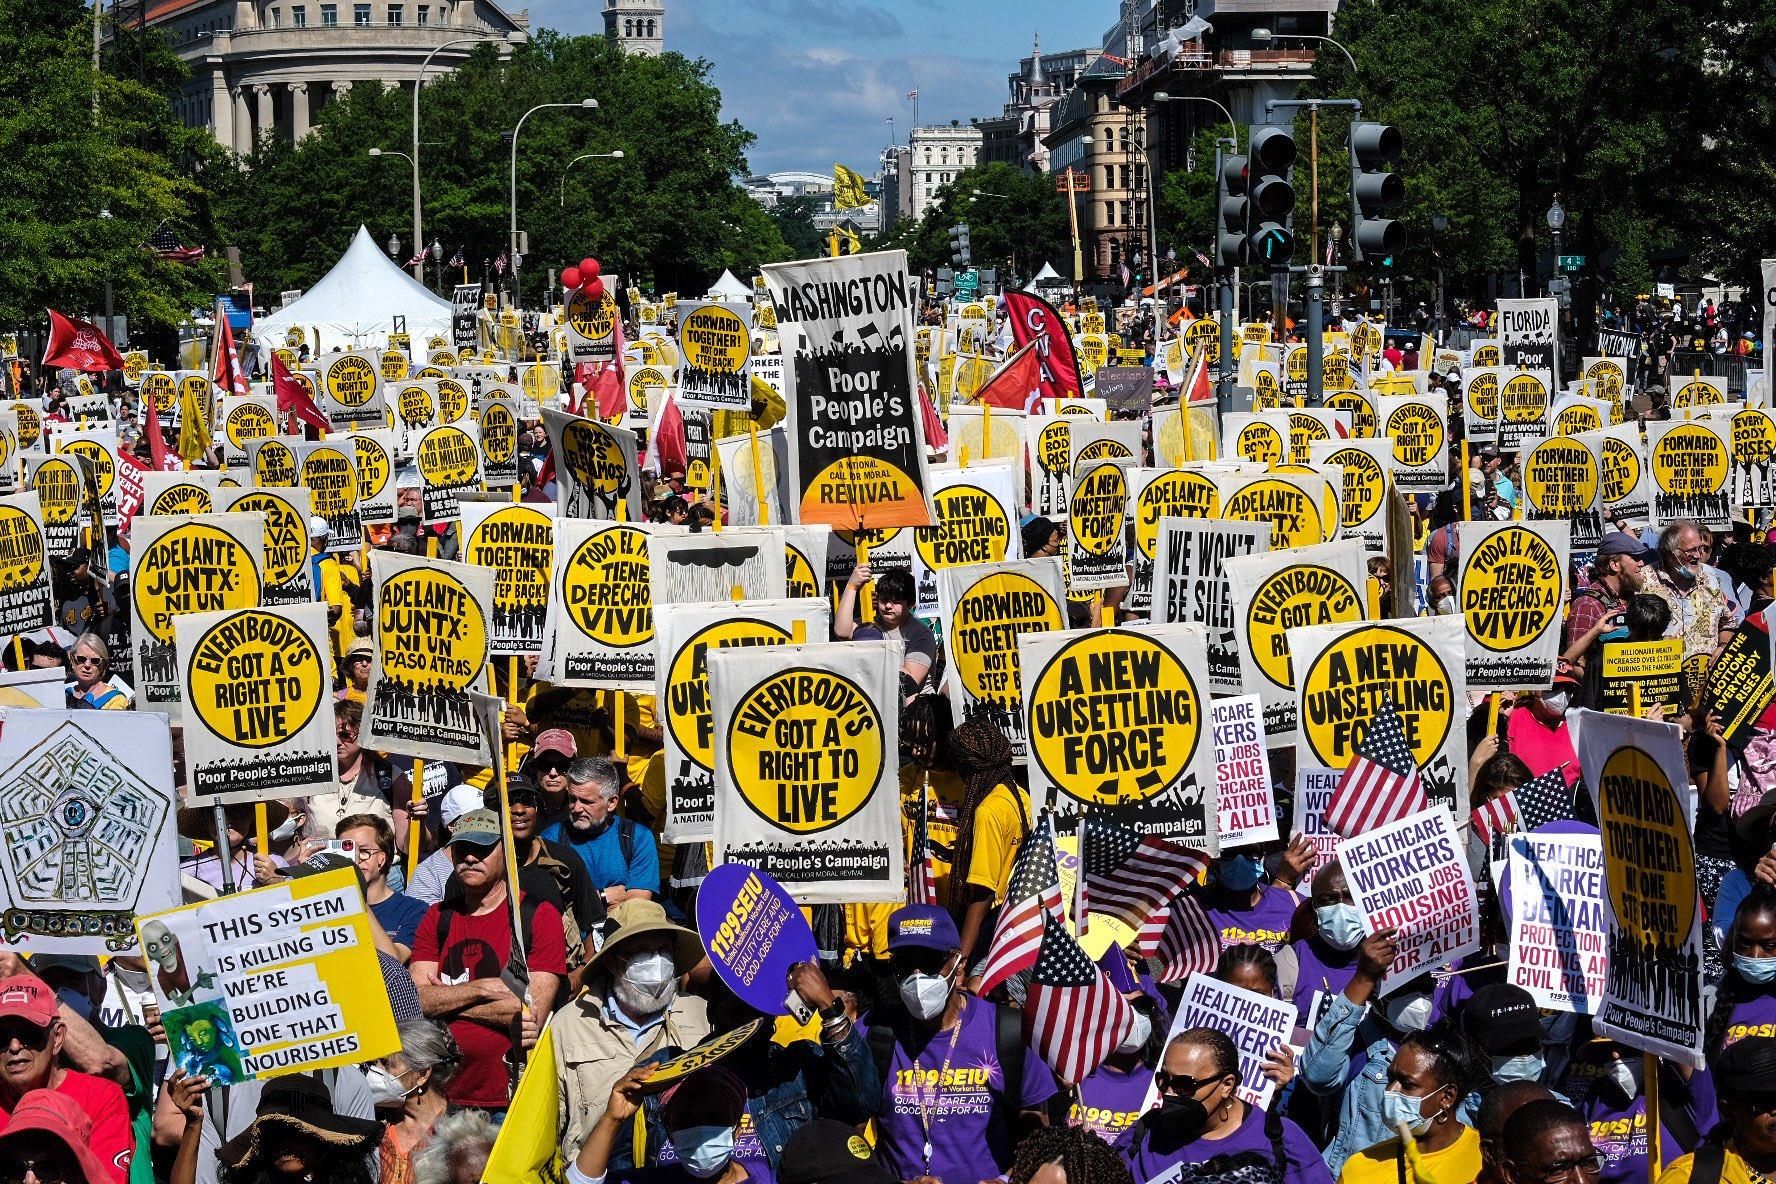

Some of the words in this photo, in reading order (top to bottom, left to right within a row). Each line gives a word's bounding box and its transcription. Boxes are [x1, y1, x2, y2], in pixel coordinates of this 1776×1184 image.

[769, 270, 907, 324] WASHINGTON
[577, 321, 611, 334] VIVIR
[690, 315, 740, 332] FORWARD
[1192, 325, 1198, 335] A
[1200, 325, 1217, 334] NEW
[1503, 309, 1550, 331] FLORIDA
[687, 330, 741, 347] TOGETHER!
[330, 357, 372, 379] EVERYBODY'S
[1518, 351, 1543, 364] Poor
[155, 378, 170, 387] NEW
[337, 382, 357, 392] RIGHT
[358, 381, 368, 390] TO
[829, 368, 880, 393] Poor
[1099, 371, 1146, 380] Elections
[344, 392, 363, 405] LIVE
[811, 392, 903, 425] People's
[229, 405, 275, 432] EVERYBODY'S
[240, 419, 254, 427] GOT
[256, 418, 261, 427] A
[1390, 405, 1441, 430] EVERYBODY'S
[488, 436, 508, 452] FORCE
[809, 426, 910, 453] Campaign
[1663, 436, 1717, 451] FORWARD
[305, 459, 347, 473] FORWARD
[1404, 448, 1428, 462] LIVE
[1535, 450, 1588, 465] FORWARD
[1659, 452, 1719, 467] TOGETHER!
[60, 470, 73, 484] THE
[1532, 468, 1589, 483] TOGETHER!
[821, 481, 904, 504] REVIVAL
[1143, 481, 1214, 507] ADELANTE
[1230, 490, 1303, 515] ADELANTE
[949, 496, 988, 518] NEW
[1074, 494, 1123, 518] UNSETTLING
[13, 516, 29, 534] THE
[1082, 515, 1114, 538] FORCE
[146, 537, 237, 573] ADELANTE
[577, 534, 616, 571] TODO
[621, 531, 634, 555] EL
[934, 538, 991, 564] FORCE
[601, 562, 649, 583] TIENE
[1493, 563, 1536, 586] TIENE
[382, 581, 466, 617] ADELANTE
[515, 583, 546, 599] BACK!
[1167, 578, 1187, 623] BE
[1253, 570, 1354, 625] EVERYBODY'S
[5, 603, 44, 621] SILENT
[962, 592, 1046, 624] FORWARD
[1281, 602, 1312, 630] GOT
[1318, 600, 1333, 624] A
[1472, 610, 1544, 640] VIVIR
[196, 616, 312, 674] EVERYBODY'S
[396, 635, 419, 652] NI
[428, 636, 451, 657] UN
[492, 640, 523, 650] People's
[385, 651, 426, 670] PASO
[430, 656, 472, 676] ATRAS
[568, 661, 591, 670] Poor
[595, 661, 633, 672] People's
[983, 654, 1007, 672] NOT
[1059, 656, 1084, 698] A
[1089, 650, 1162, 692] NEW
[1328, 651, 1352, 688] A
[1355, 643, 1419, 682] NEW
[1477, 667, 1519, 679] People's
[1521, 666, 1551, 677] Campaign
[1713, 653, 1746, 696] BOTTOM
[978, 673, 1009, 691] STEP
[1715, 650, 1761, 711] EVERYBODY
[736, 676, 874, 739] EVERYBODY'S
[1035, 690, 1192, 739] UNSETTLING
[233, 704, 288, 741] LIVE
[373, 720, 393, 731] Poor
[397, 722, 434, 737] People's
[436, 728, 480, 744] Campaign
[774, 718, 817, 749] GOT
[822, 718, 841, 747] A
[1063, 727, 1167, 775] FORCE
[1230, 743, 1261, 761] JOBS
[198, 772, 226, 785] Poor
[230, 766, 276, 781] People's
[280, 762, 330, 776] Campaign
[759, 751, 821, 781] RIGHT
[828, 749, 859, 779] TO
[1217, 759, 1264, 781] SING
[675, 796, 705, 809] Poor
[777, 782, 838, 824] LIVE
[1604, 774, 1674, 828] FORWARD
[1134, 815, 1202, 835] Campaign
[1230, 807, 1271, 831] ALL!
[1345, 814, 1448, 869] HEALTHCARE
[728, 855, 763, 869] Poor
[767, 855, 822, 870] People's
[826, 855, 888, 869] Campaign
[1352, 838, 1456, 894] WORKERS
[1640, 874, 1665, 895] ONE
[711, 872, 763, 960] 1199SEIU
[1368, 880, 1468, 932] HOUSING
[1640, 901, 1678, 933] BACK!
[203, 913, 263, 944] THIS
[268, 896, 345, 928] SYSTEM
[724, 946, 737, 965] United
[749, 900, 763, 921] Workers
[734, 938, 757, 977] QUALITY
[756, 915, 772, 941] CARE
[768, 898, 781, 919] AND
[743, 959, 760, 986] GOOD
[758, 938, 772, 962] JOBS
[769, 921, 781, 941] FOR
[779, 908, 790, 932] ALL
[1382, 952, 1421, 982] FOR
[1429, 927, 1474, 964] ALL!
[1518, 946, 1580, 971] VOTING
[1410, 954, 1443, 973] 1199SEIU
[232, 990, 328, 1024] BUILDING
[1190, 982, 1290, 1034] HEALTHCARE
[1183, 1005, 1282, 1058] WORKERS
[1605, 1009, 1624, 1025] Poor
[1625, 1013, 1655, 1034] People's
[1656, 1020, 1695, 1045] Campaign
[244, 1035, 358, 1074] NOURISHES
[895, 1106, 921, 1114] GOOD
[951, 1107, 970, 1115] FOR
[972, 1105, 988, 1113] ALL
[939, 1097, 967, 1105] CARE
[968, 1096, 990, 1104] AND
